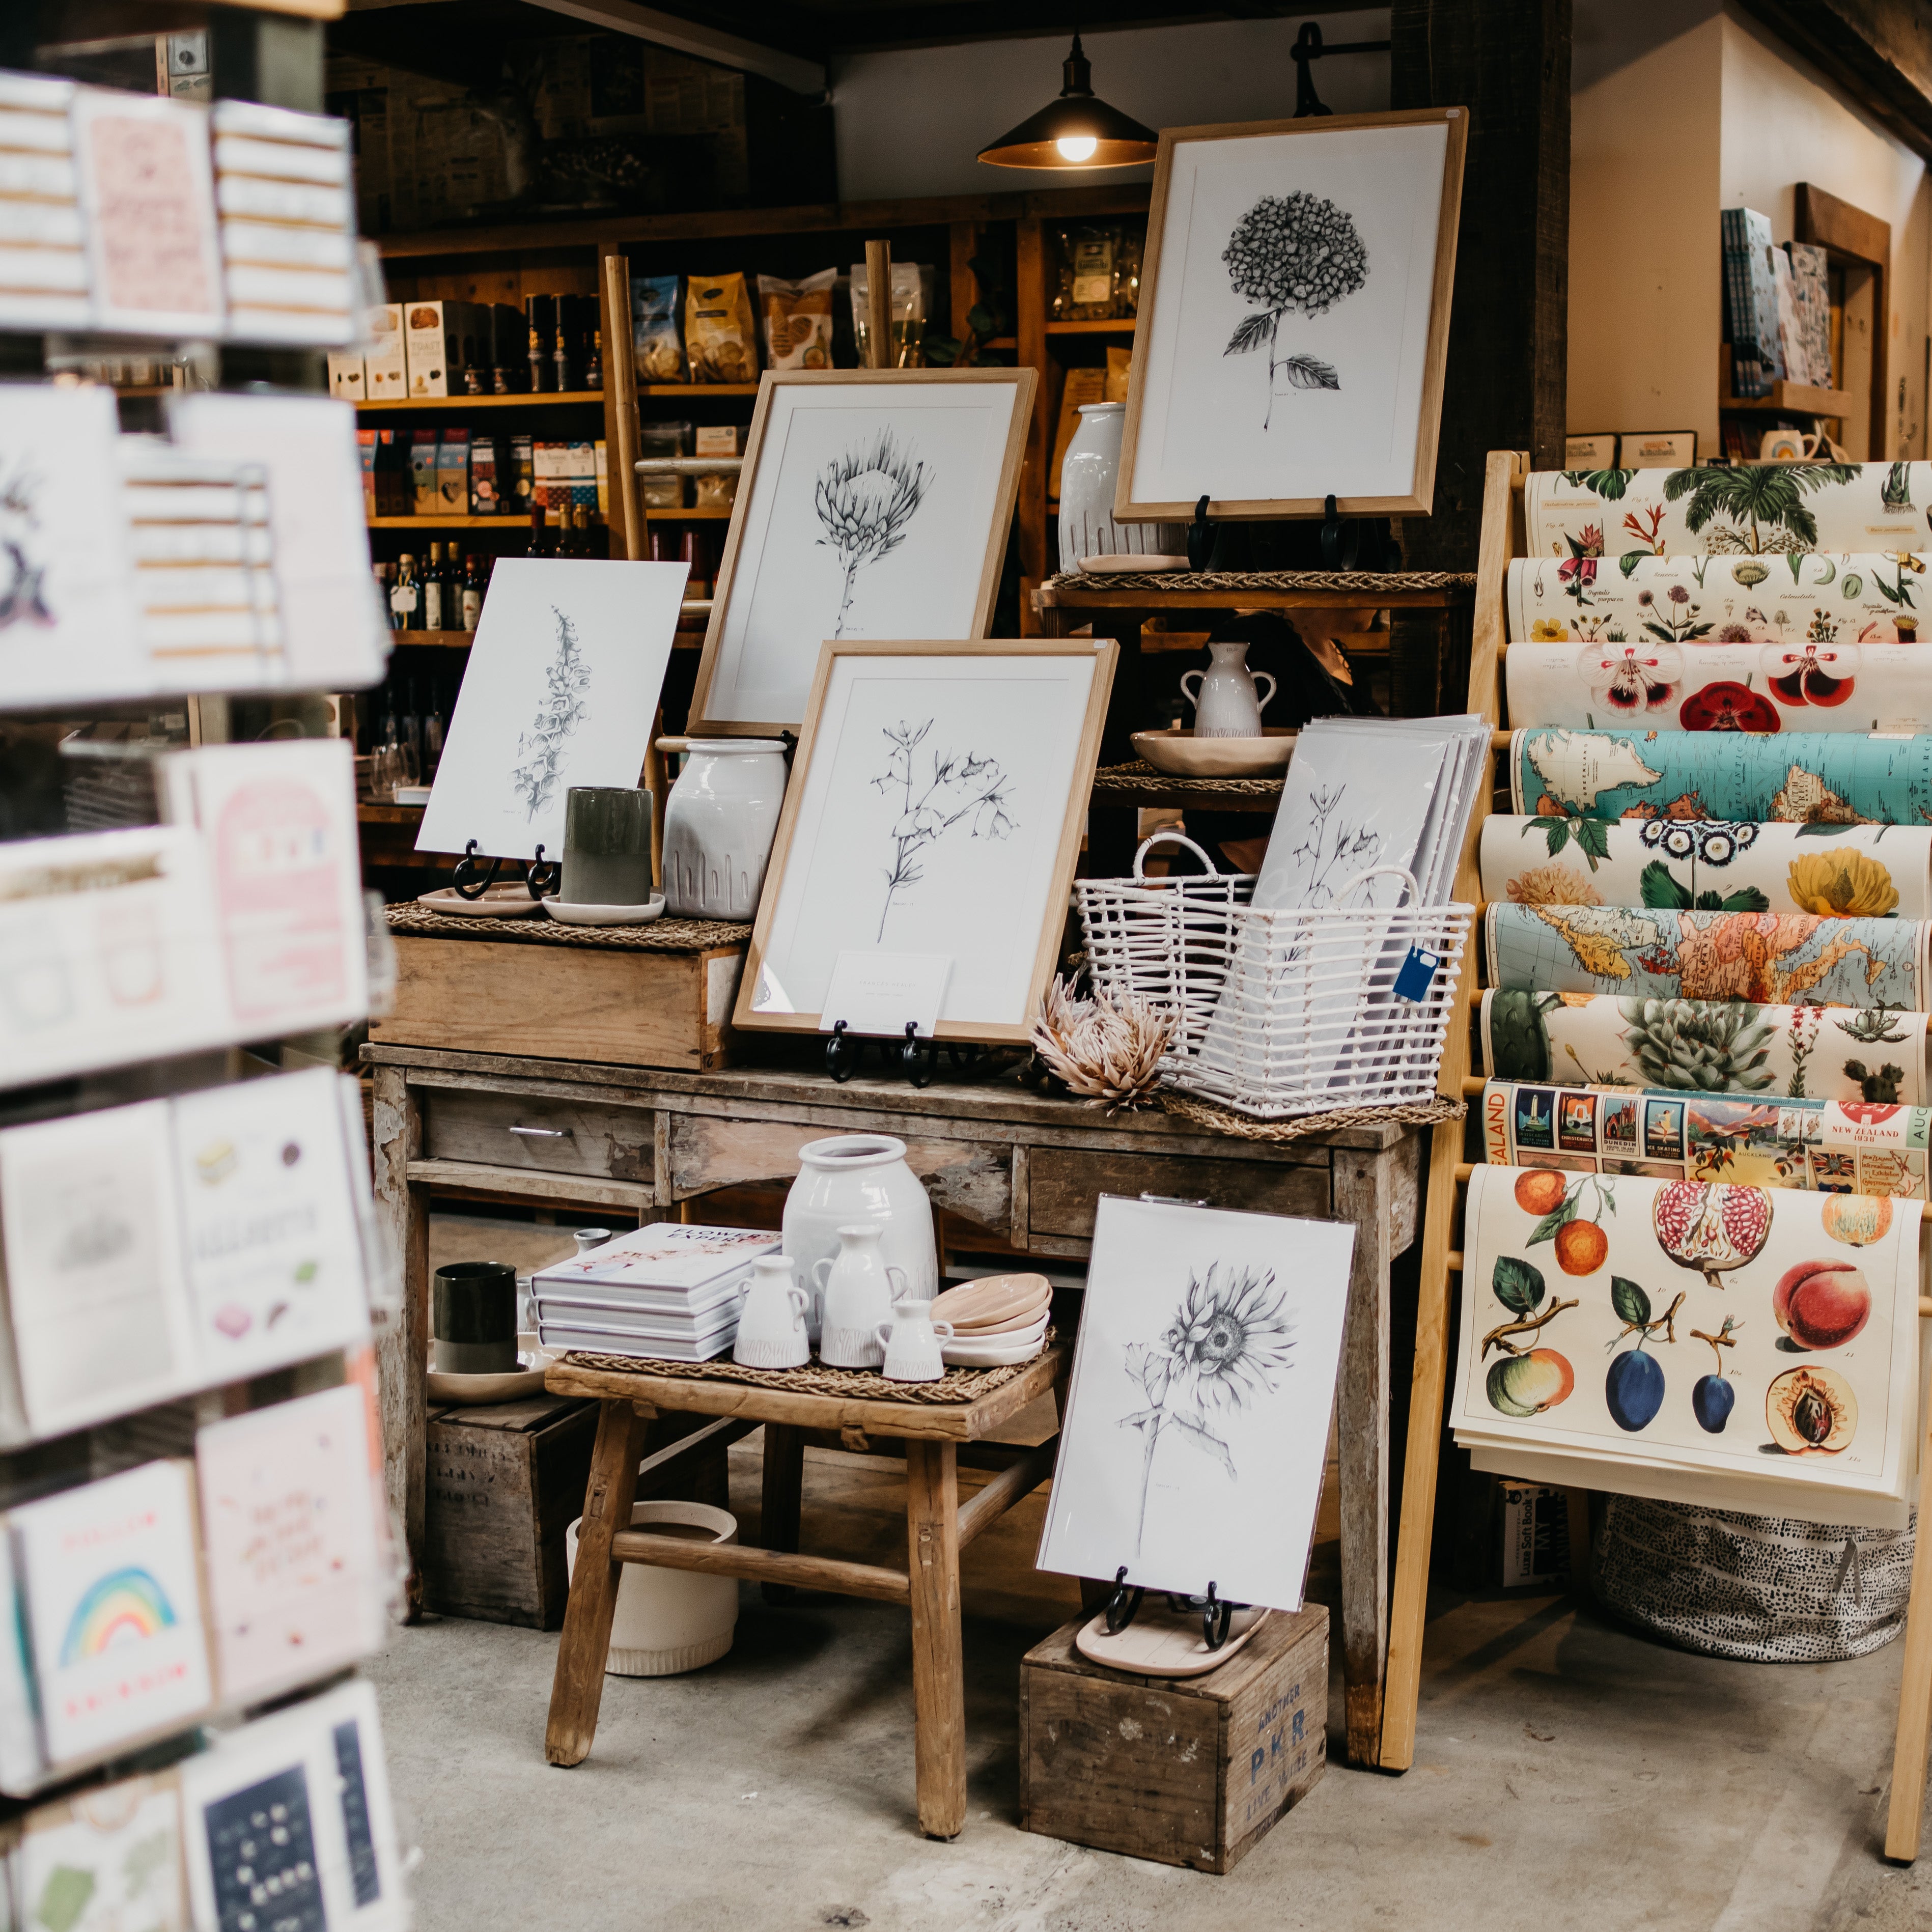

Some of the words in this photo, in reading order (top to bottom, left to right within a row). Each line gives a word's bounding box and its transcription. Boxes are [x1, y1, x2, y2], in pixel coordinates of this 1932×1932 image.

[1735, 747, 1743, 813] ATLANTIC
[1700, 934, 1710, 990] GERMANY
[1832, 1126, 1852, 1134] NEW
[1855, 1128, 1899, 1138] ZEALAND
[1862, 1162, 1895, 1170] International
[667, 1234, 748, 1243] EXPERT
[1522, 1498, 1532, 1525] Book
[1521, 1527, 1532, 1549] Soft
[1535, 1522, 1550, 1550] MY
[1520, 1551, 1531, 1577] Luxe
